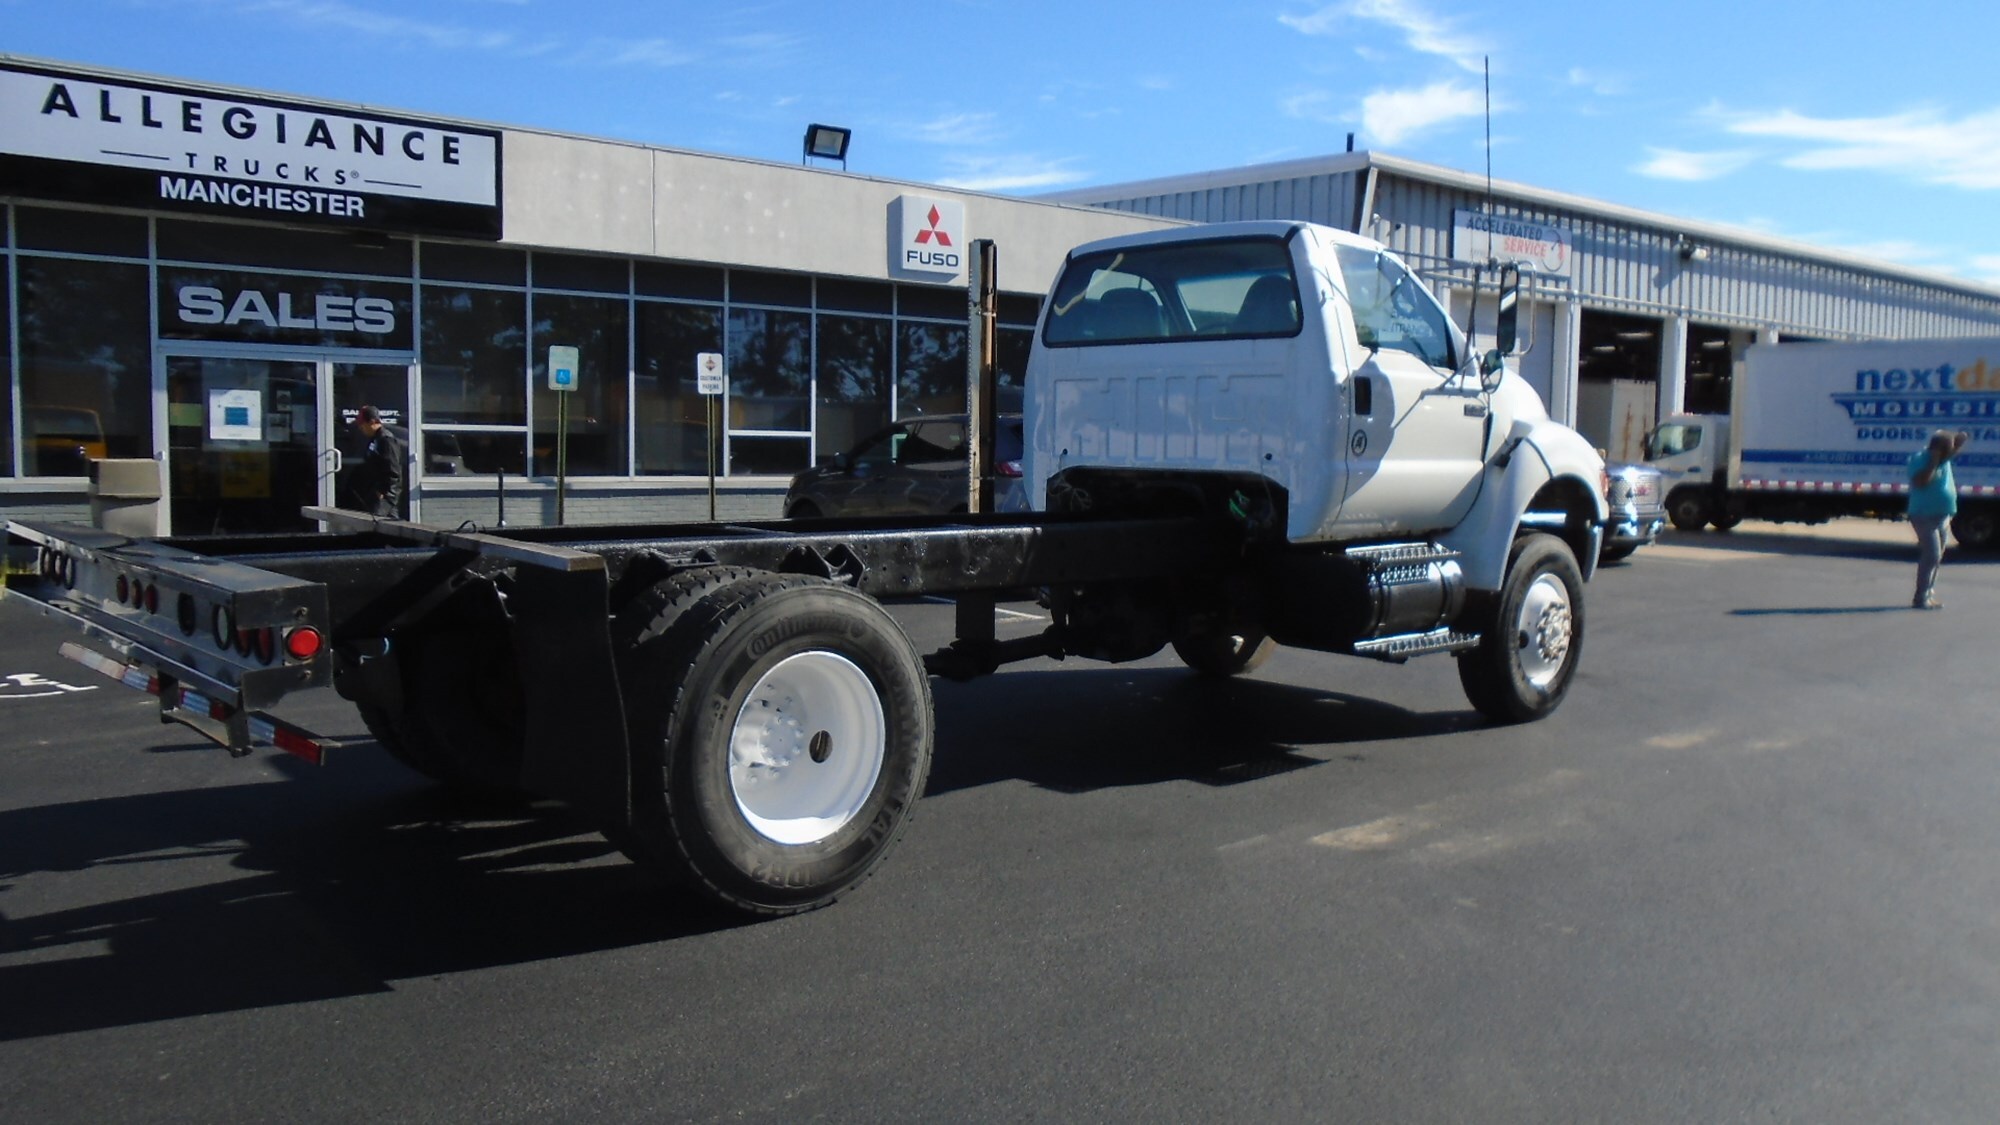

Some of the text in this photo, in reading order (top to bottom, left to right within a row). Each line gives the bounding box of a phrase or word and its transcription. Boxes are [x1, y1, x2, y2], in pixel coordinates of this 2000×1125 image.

[41, 83, 461, 165] ALLEGIANCE
[160, 175, 365, 218] MANCHESTER
[1466, 216, 1543, 240] ACCELERATED
[907, 250, 959, 267] FUSO
[1504, 237, 1548, 257] SERVICE
[178, 286, 396, 334] SALES
[1853, 401, 2000, 417] MOULDI
